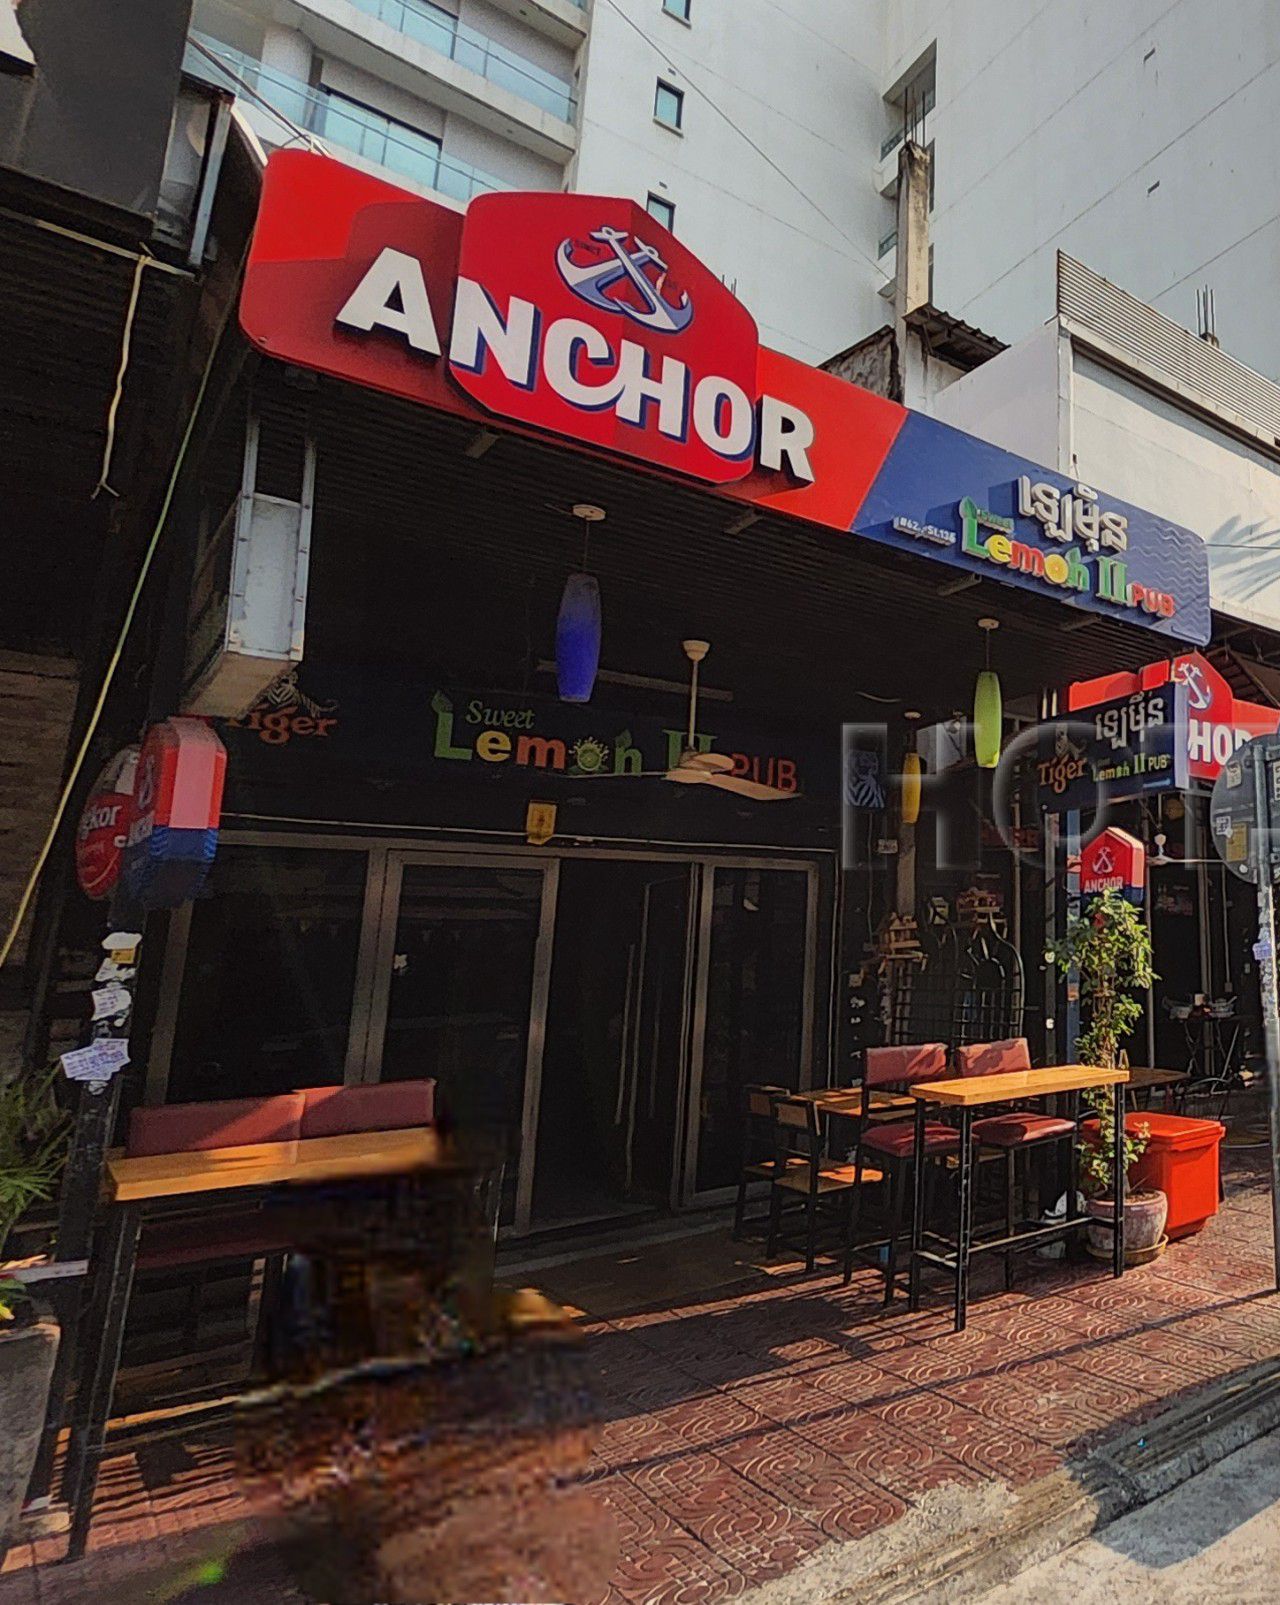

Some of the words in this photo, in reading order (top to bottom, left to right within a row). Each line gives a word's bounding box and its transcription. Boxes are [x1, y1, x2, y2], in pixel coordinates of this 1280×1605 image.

[335, 246, 815, 484] ANCHOR
[959, 496, 1090, 591] Lemon
[1126, 582, 1177, 618] PUB
[430, 690, 643, 777] Lemon
[730, 752, 799, 795] PUB
[466, 701, 536, 729] Sweet
[1037, 753, 1087, 793] Tiger
[1083, 876, 1124, 894] ANCHOR
